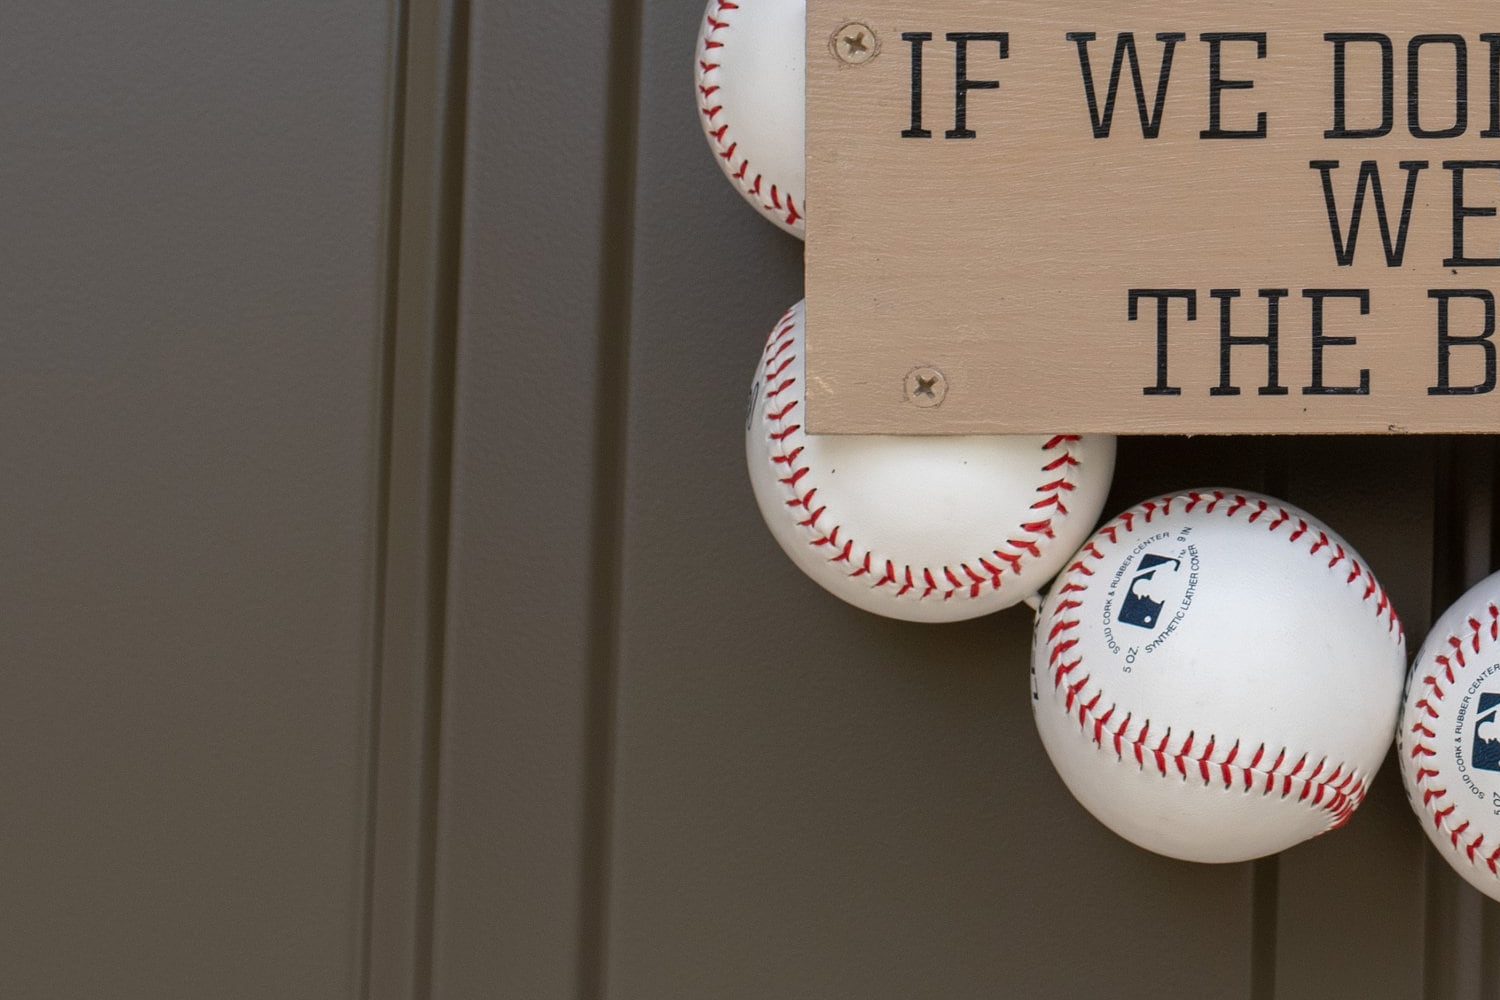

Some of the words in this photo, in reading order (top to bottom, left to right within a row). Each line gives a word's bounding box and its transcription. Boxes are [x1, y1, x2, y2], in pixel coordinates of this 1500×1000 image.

[902, 32, 1008, 139] IF
[1067, 32, 1266, 139] WE
[1128, 288, 1369, 396] THE
[1133, 531, 1171, 555] CENTER
[1187, 544, 1200, 571] COVER
[1111, 554, 1134, 589] RUBBER
[1182, 572, 1199, 612] LEATHER
[1103, 599, 1113, 626] CORK
[1103, 627, 1121, 654] SOLID
[1144, 611, 1185, 654] SYNTHETIC
[1122, 666, 1132, 674] 5
[1468, 663, 1500, 695] CENTER
[1456, 696, 1471, 735] RUBBER
[1454, 745, 1466, 773] CORK
[1462, 773, 1485, 799] SOLID
